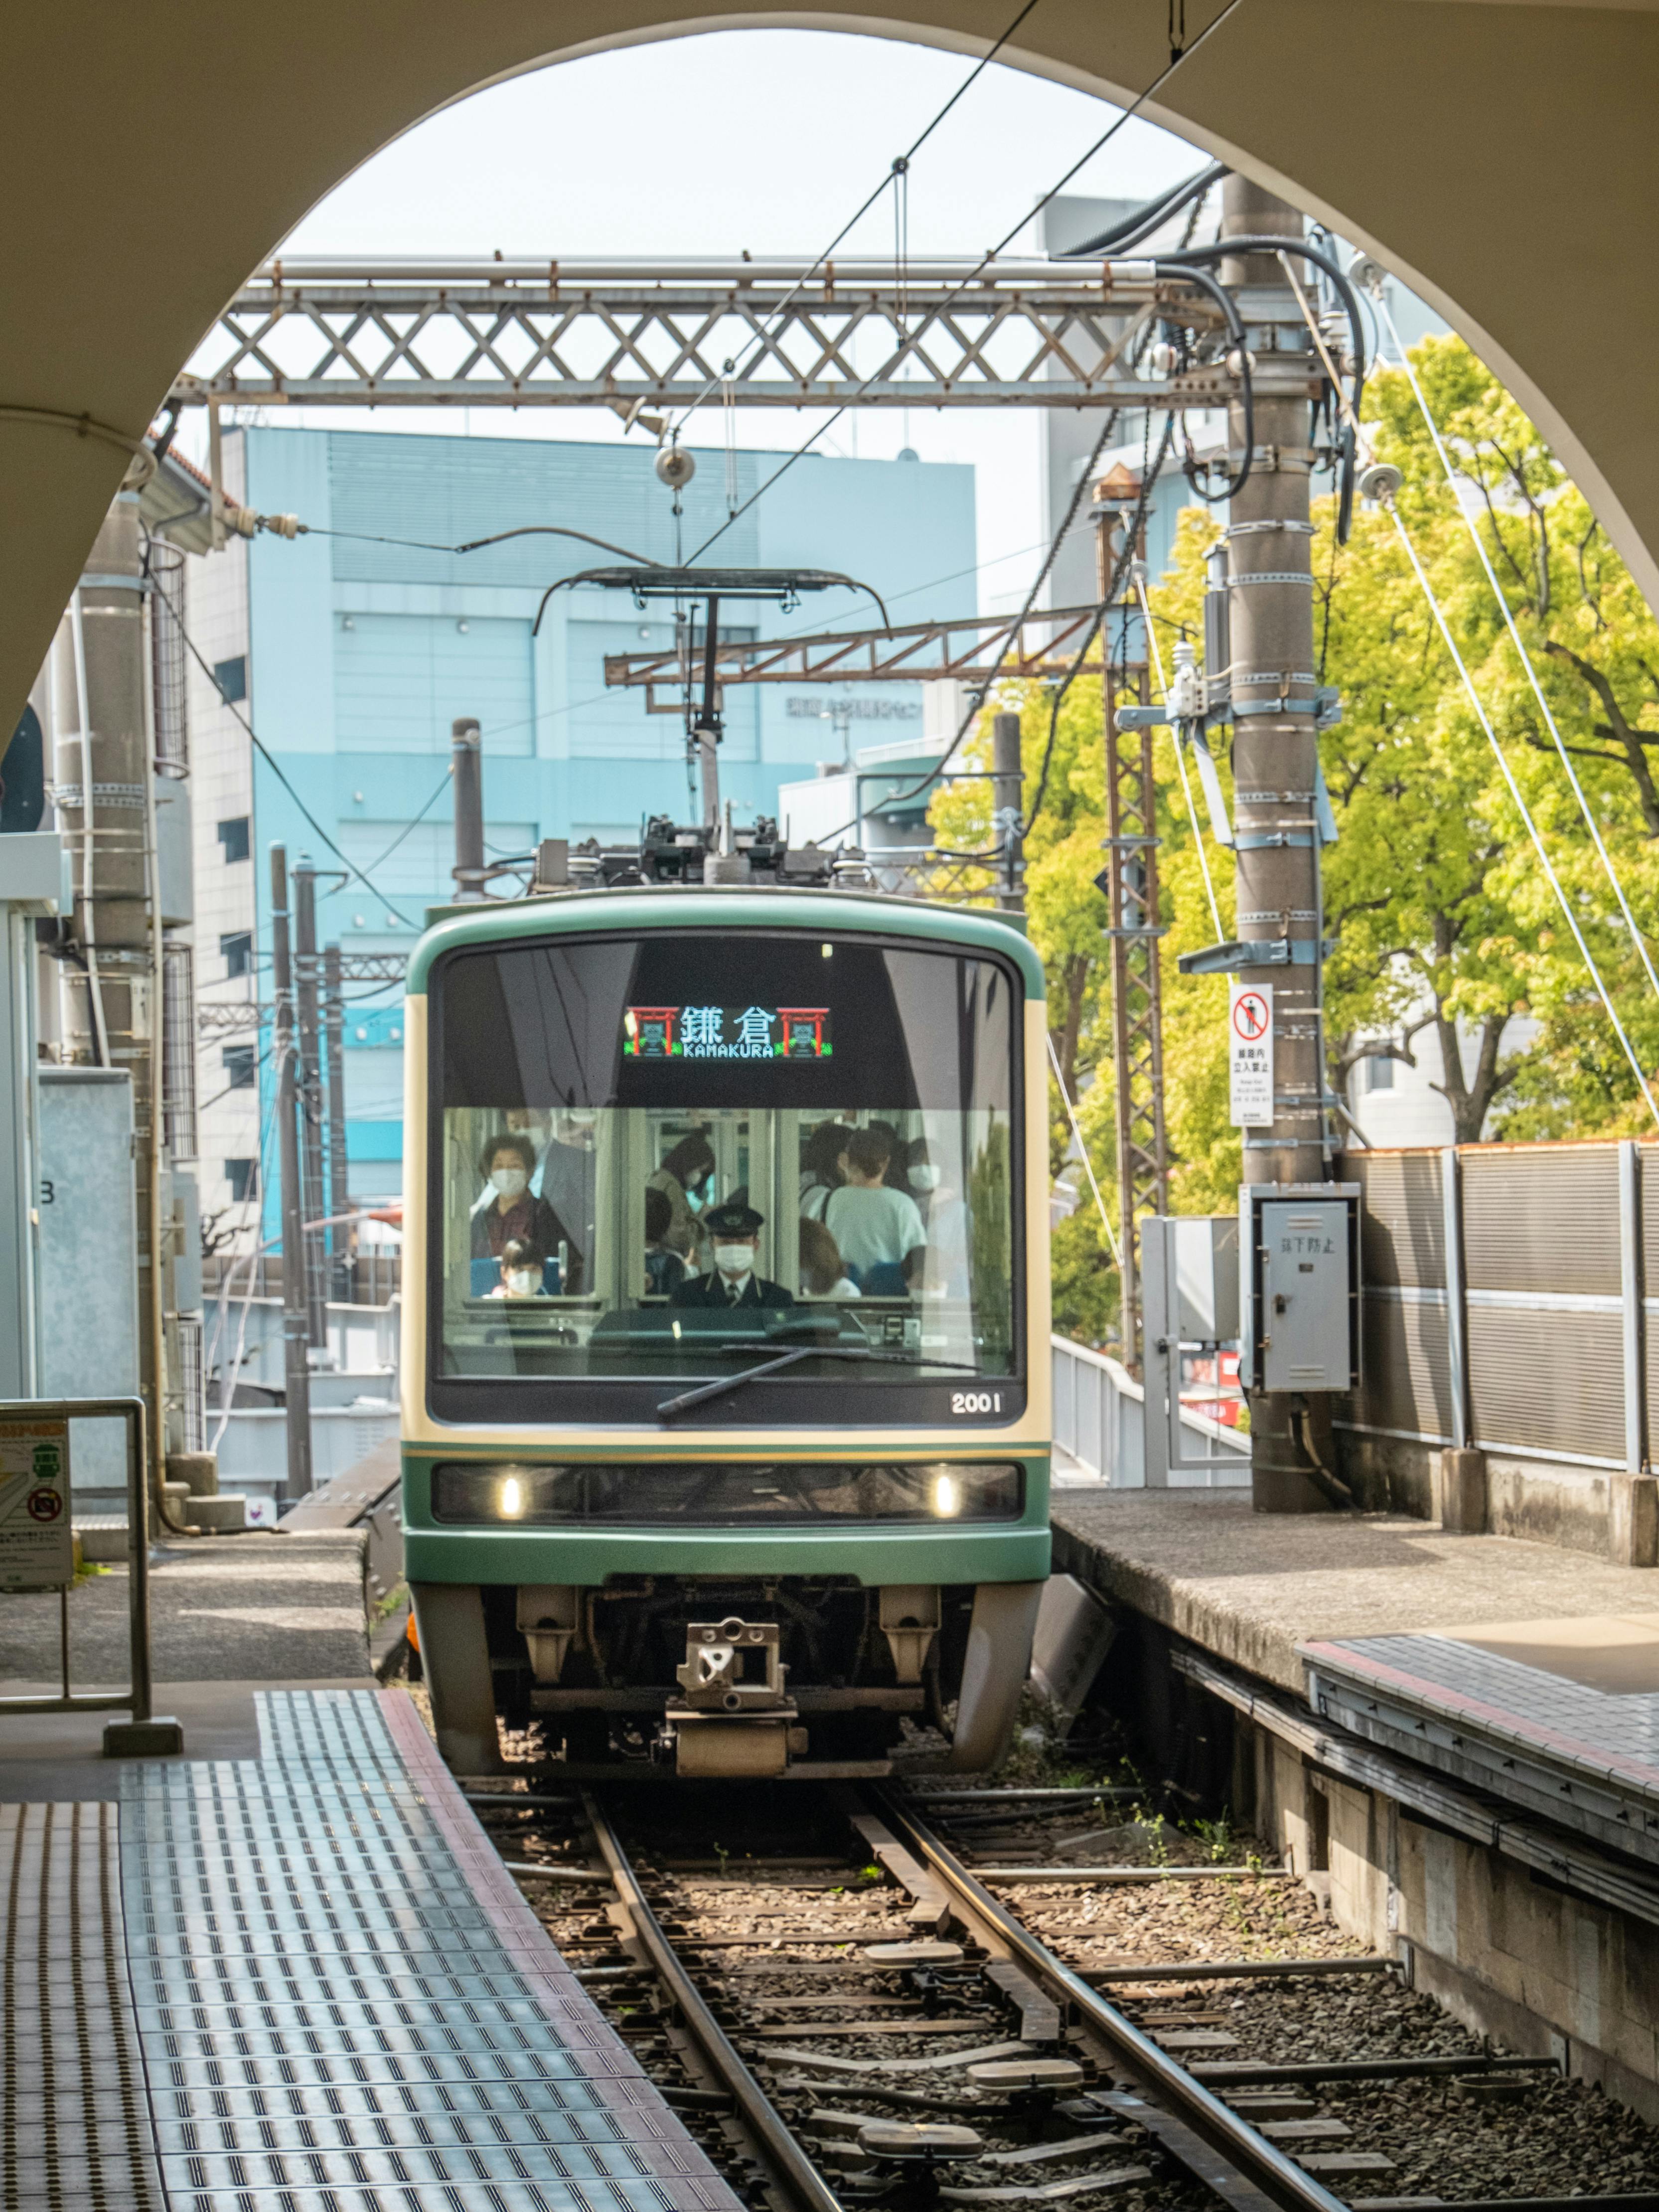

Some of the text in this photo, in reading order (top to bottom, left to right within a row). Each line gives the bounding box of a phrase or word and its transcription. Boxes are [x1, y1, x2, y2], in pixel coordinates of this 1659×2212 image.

[681, 1006, 776, 1044] 鎌倉
[683, 1044, 774, 1058] KAMAKURA
[952, 1393, 1001, 1413] 2001
